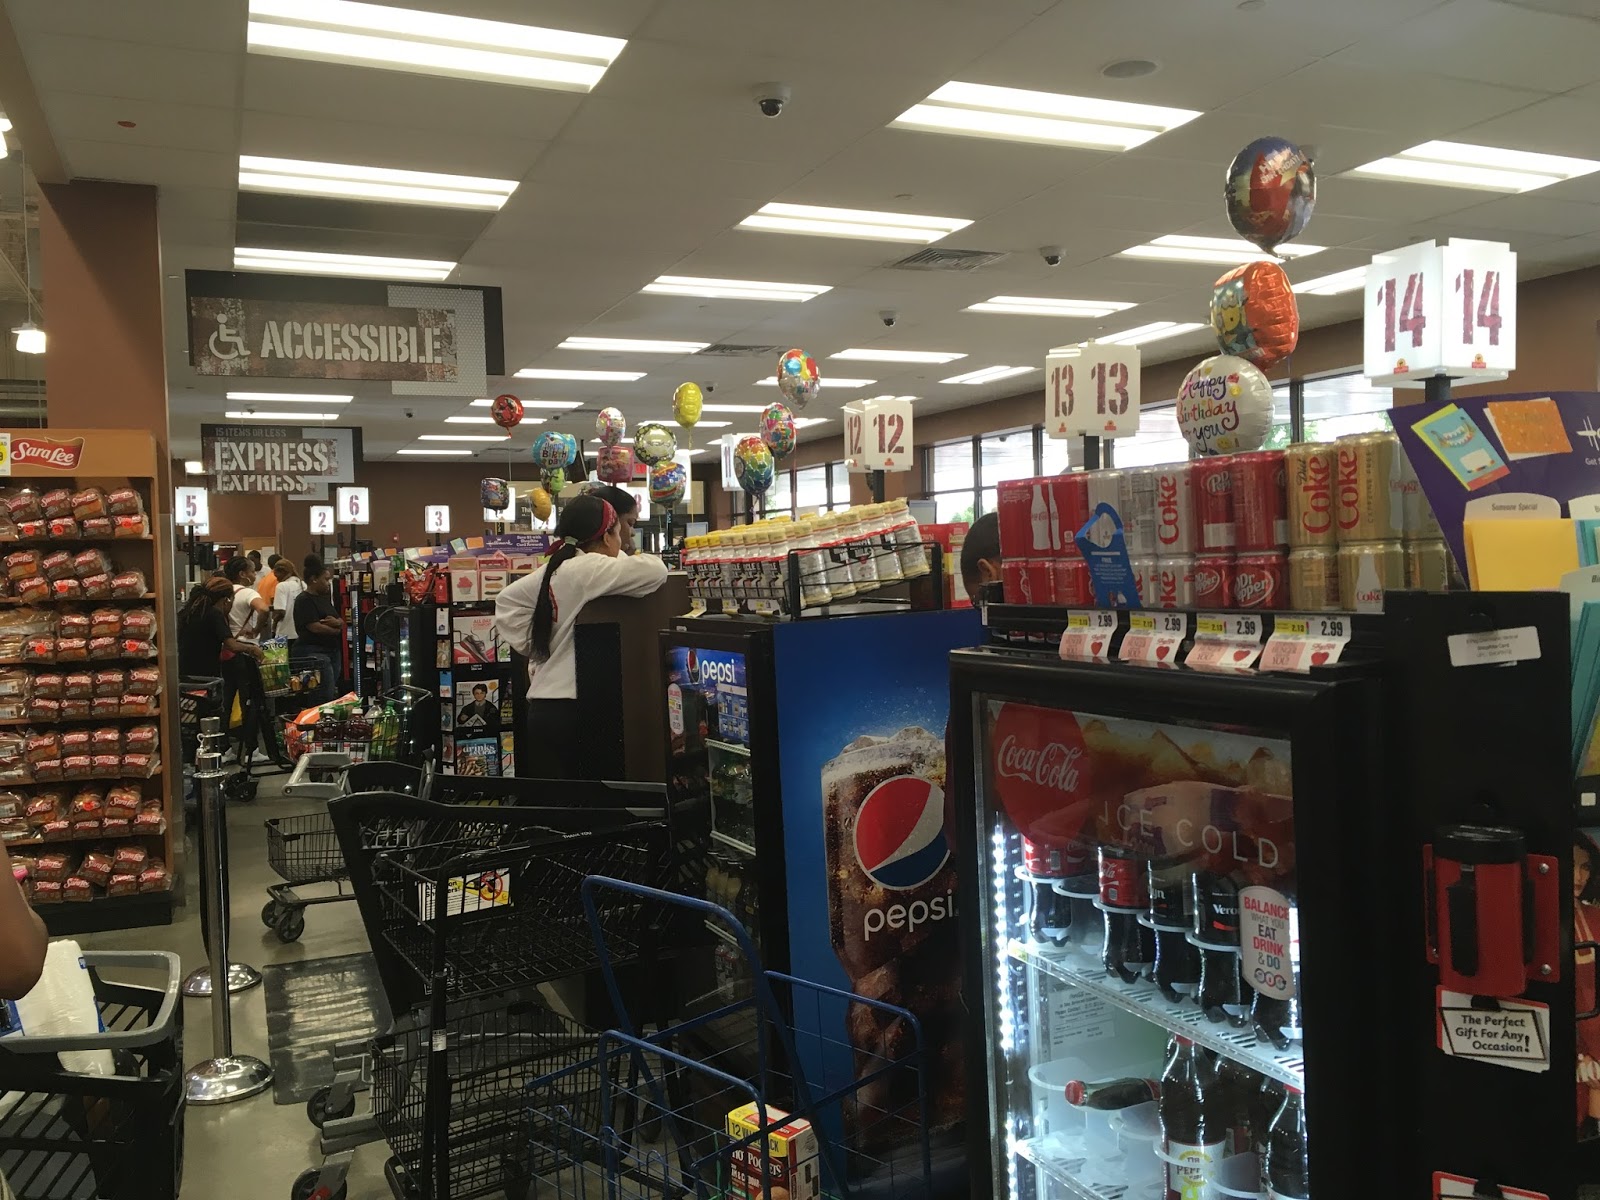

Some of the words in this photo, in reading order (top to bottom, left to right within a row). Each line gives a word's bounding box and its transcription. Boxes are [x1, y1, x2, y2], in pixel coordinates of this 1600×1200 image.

[1377, 271, 1426, 352] 14
[1455, 269, 1502, 346] 14
[260, 320, 442, 364] ACCESSIBLE
[1051, 364, 1074, 417] 13
[1091, 362, 1129, 416] 13
[1181, 369, 1227, 400] Happy
[1176, 399, 1240, 431] Birthday
[215, 427, 224, 437] 15
[226, 428, 250, 437] ITEMS
[253, 428, 263, 437] OR
[265, 428, 286, 438] LESS
[848, 415, 862, 455] 12
[873, 414, 904, 453] 12
[1193, 423, 1226, 453] you
[11, 442, 51, 461] Sara
[46, 448, 74, 466] Lee
[214, 442, 329, 472] EXPRESS
[217, 475, 308, 491] EXPRESS
[1303, 456, 1331, 534] Coke
[1338, 449, 1359, 530] Coke
[186, 495, 197, 517] 5
[349, 495, 360, 516] 6
[1158, 475, 1179, 545] Coke
[1491, 503, 1517, 511] Someone
[1518, 503, 1538, 511] Special
[318, 512, 327, 528] 2
[434, 511, 443, 527] 3
[1098, 615, 1112, 628] 2.99
[1165, 617, 1181, 631] 2.99
[1237, 620, 1256, 635] 2.99
[1321, 620, 1343, 636] 2.99
[702, 659, 735, 684] pepsi
[463, 743, 495, 753] drinks
[997, 734, 1082, 793] Coca-Cola
[1098, 801, 1154, 837] ICE
[1176, 819, 1279, 869] COLD
[864, 889, 953, 941] pepsi
[1244, 896, 1289, 920] BALANCE
[1251, 913, 1269, 925] WHAT
[1272, 918, 1284, 930] YOU
[1258, 924, 1276, 940] EAT
[1253, 937, 1284, 957] DRINK
[1267, 954, 1280, 970] DO
[1461, 1015, 1481, 1025] The
[1485, 1016, 1525, 1028] Perfect
[1456, 1027, 1478, 1039] Gift
[1481, 1028, 1499, 1038] For
[1501, 1030, 1524, 1042] Any
